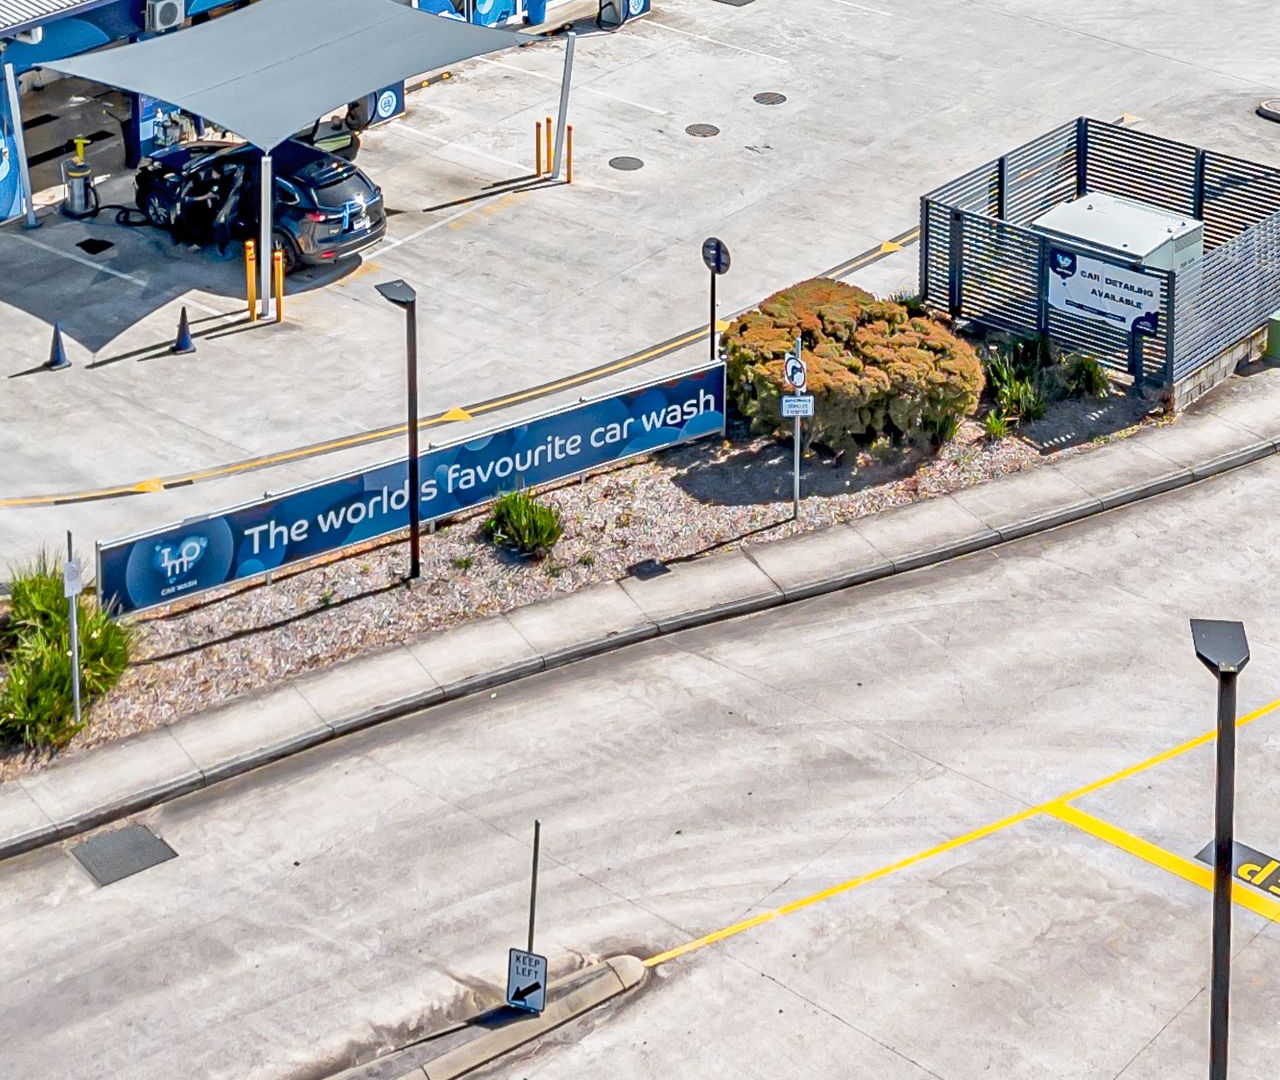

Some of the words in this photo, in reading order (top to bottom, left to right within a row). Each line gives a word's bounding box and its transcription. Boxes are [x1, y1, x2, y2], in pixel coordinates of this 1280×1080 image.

[1080, 270, 1100, 282] CAR
[1090, 288, 1144, 310] AVAILABLE
[245, 513, 309, 555] The
[316, 471, 438, 531] worlds
[446, 433, 583, 495] favourite
[590, 416, 635, 446] car
[641, 389, 716, 432] wash
[515, 954, 540, 968] KEEP
[516, 966, 539, 980] LEFT
